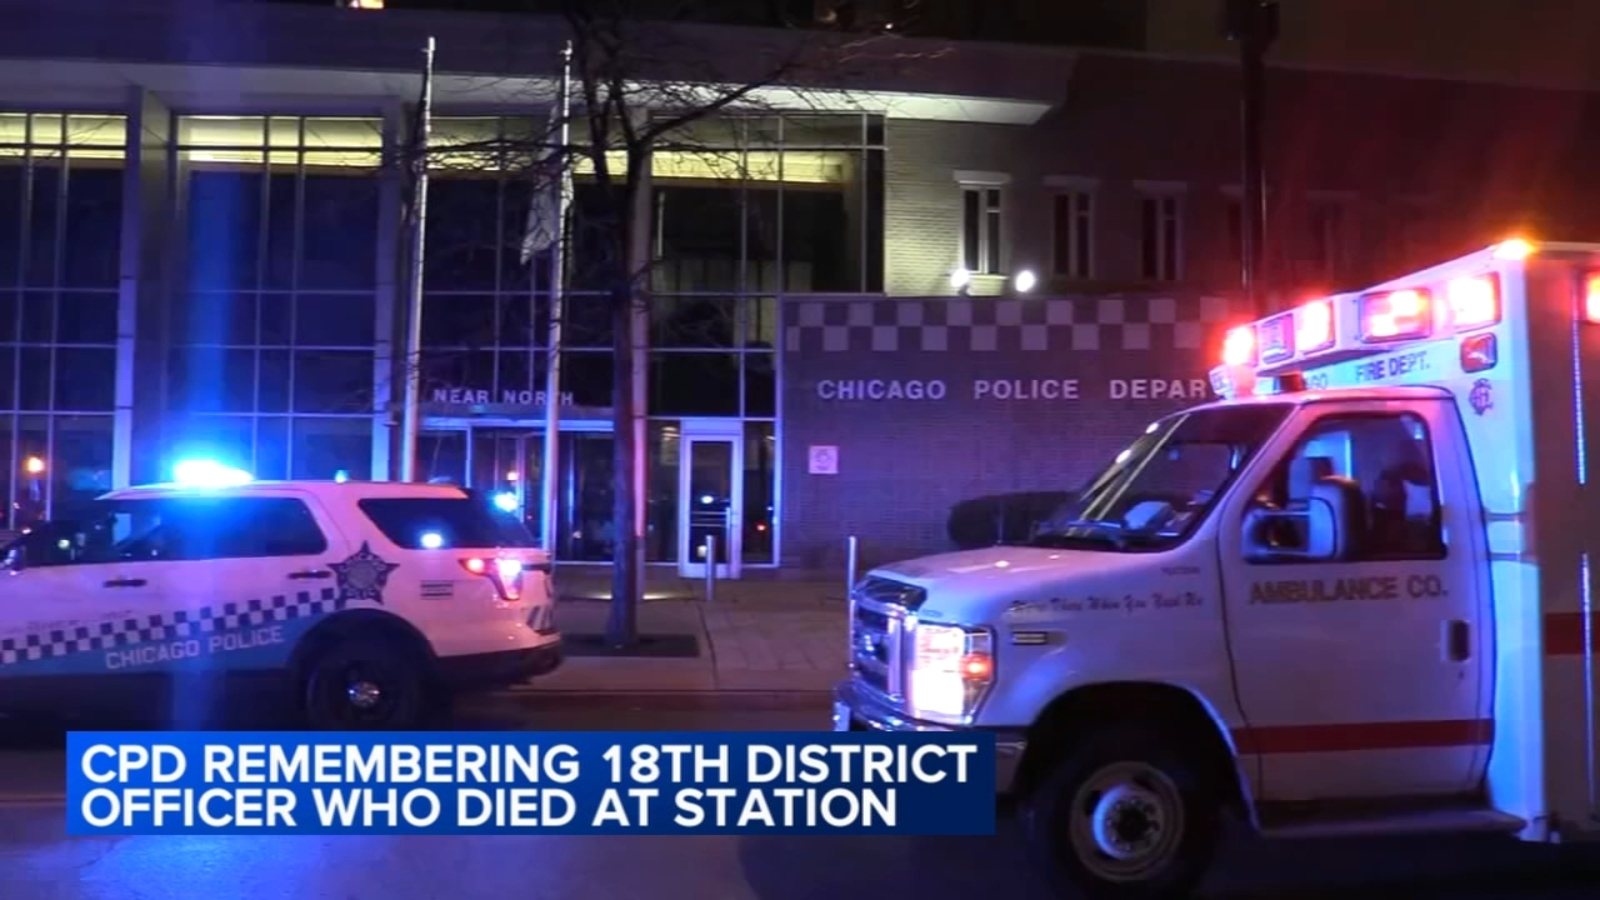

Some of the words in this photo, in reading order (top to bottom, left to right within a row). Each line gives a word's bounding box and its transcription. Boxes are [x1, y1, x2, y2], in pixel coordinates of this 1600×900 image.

[1355, 360, 1386, 381] FIRE
[1389, 351, 1431, 376] DEPT.
[434, 389, 489, 404] NEAR
[503, 390, 574, 406] NORH
[817, 379, 947, 400] CHICAGO
[974, 379, 1079, 399] POLICE
[1110, 379, 1207, 399] DEPAR
[1250, 576, 1398, 604] AMBULANCE
[1407, 574, 1449, 598] CO.
[105, 639, 201, 669] CHICAGO
[208, 625, 285, 653] POLICE
